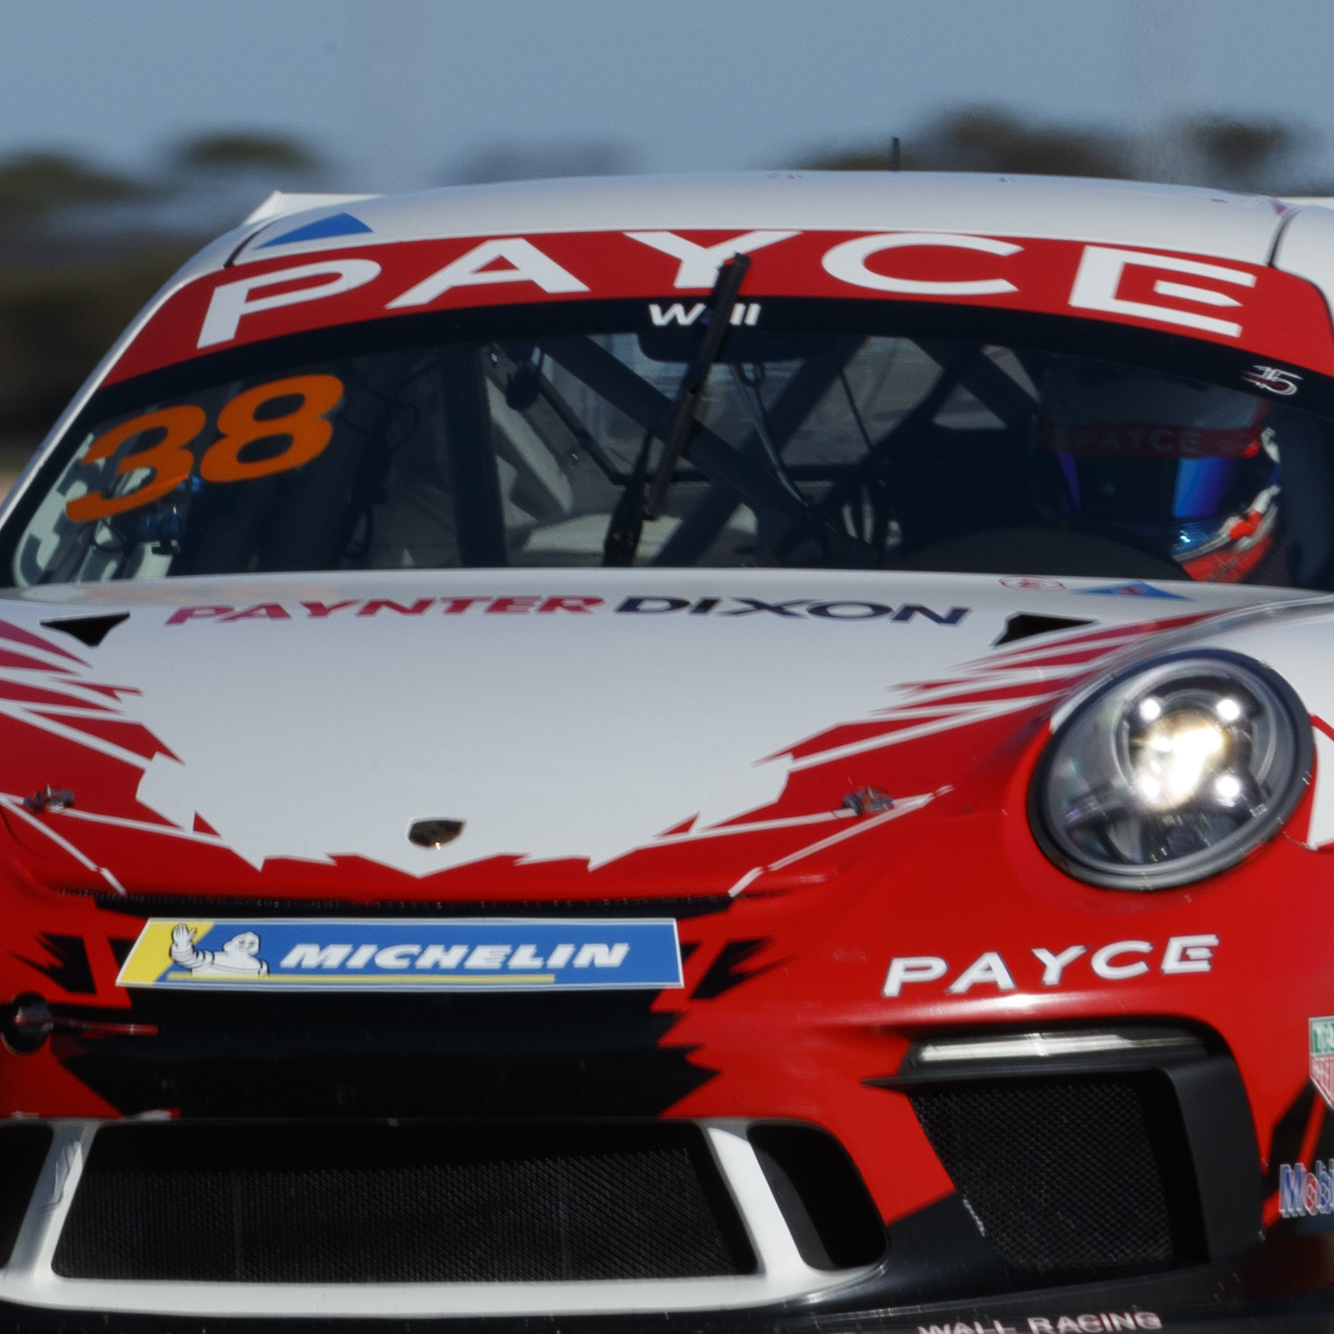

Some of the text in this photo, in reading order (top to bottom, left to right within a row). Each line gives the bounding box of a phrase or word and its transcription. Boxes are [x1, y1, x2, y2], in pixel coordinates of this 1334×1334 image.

[196, 230, 1258, 350] PAYCE
[648, 302, 762, 326] Wll
[66, 374, 344, 522] 38
[164, 596, 971, 626] PAYNTER DIXON
[279, 942, 629, 970] MICHELIN
[882, 933, 1219, 998] PAYCE
